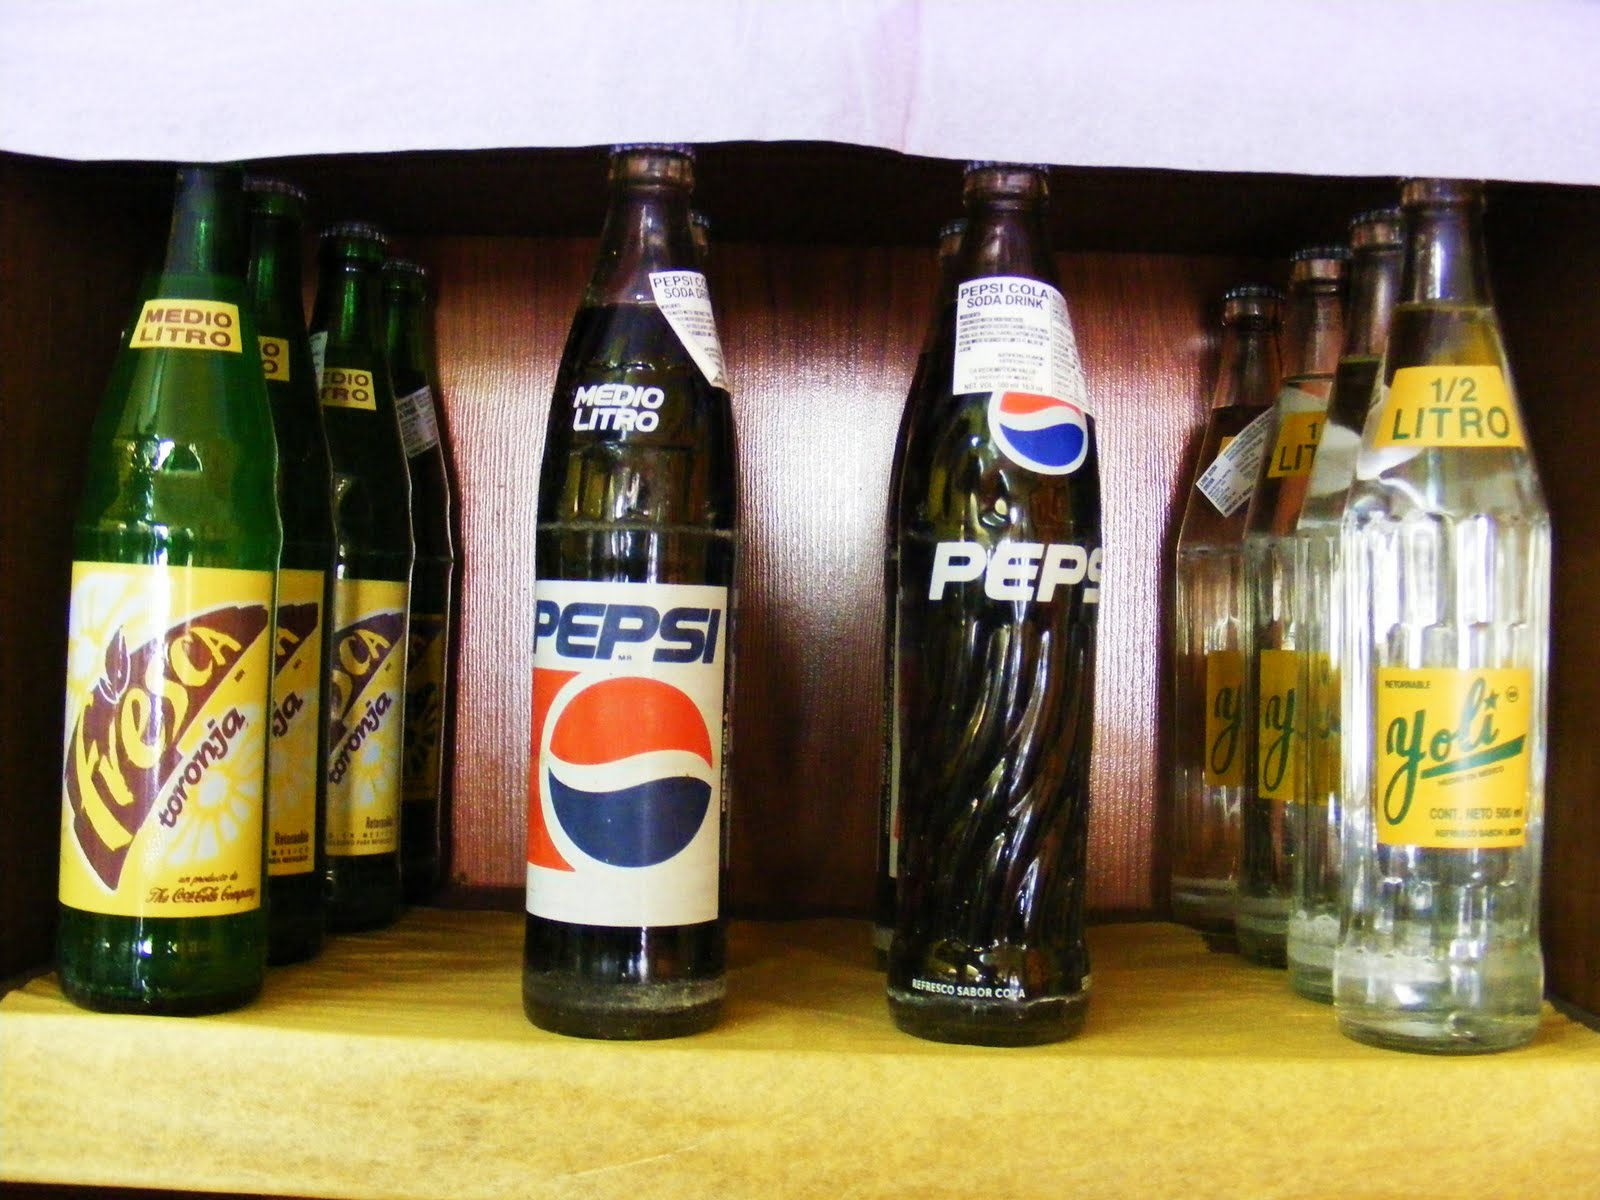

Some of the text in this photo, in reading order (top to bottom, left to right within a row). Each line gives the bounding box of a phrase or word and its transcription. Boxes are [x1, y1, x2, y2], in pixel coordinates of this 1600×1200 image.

[653, 276, 693, 288] PEPSI
[664, 287, 694, 298] SODA
[960, 283, 1049, 299] PEPSI COLA
[967, 294, 1044, 310] SODA DRINK
[144, 308, 233, 328] MEDIO
[139, 326, 231, 347] LITRO
[322, 371, 369, 387] EDIO
[1431, 376, 1477, 403] 1/2
[573, 384, 665, 409] MEDIO
[572, 407, 660, 432] LITRO
[1392, 405, 1510, 440] LITRO
[1279, 443, 1318, 471] LIT
[928, 540, 1101, 604] PEPS
[533, 599, 721, 664] PEPSI
[159, 706, 247, 828] toronja
[911, 978, 1026, 999] REFRESCO SABOR COLA
